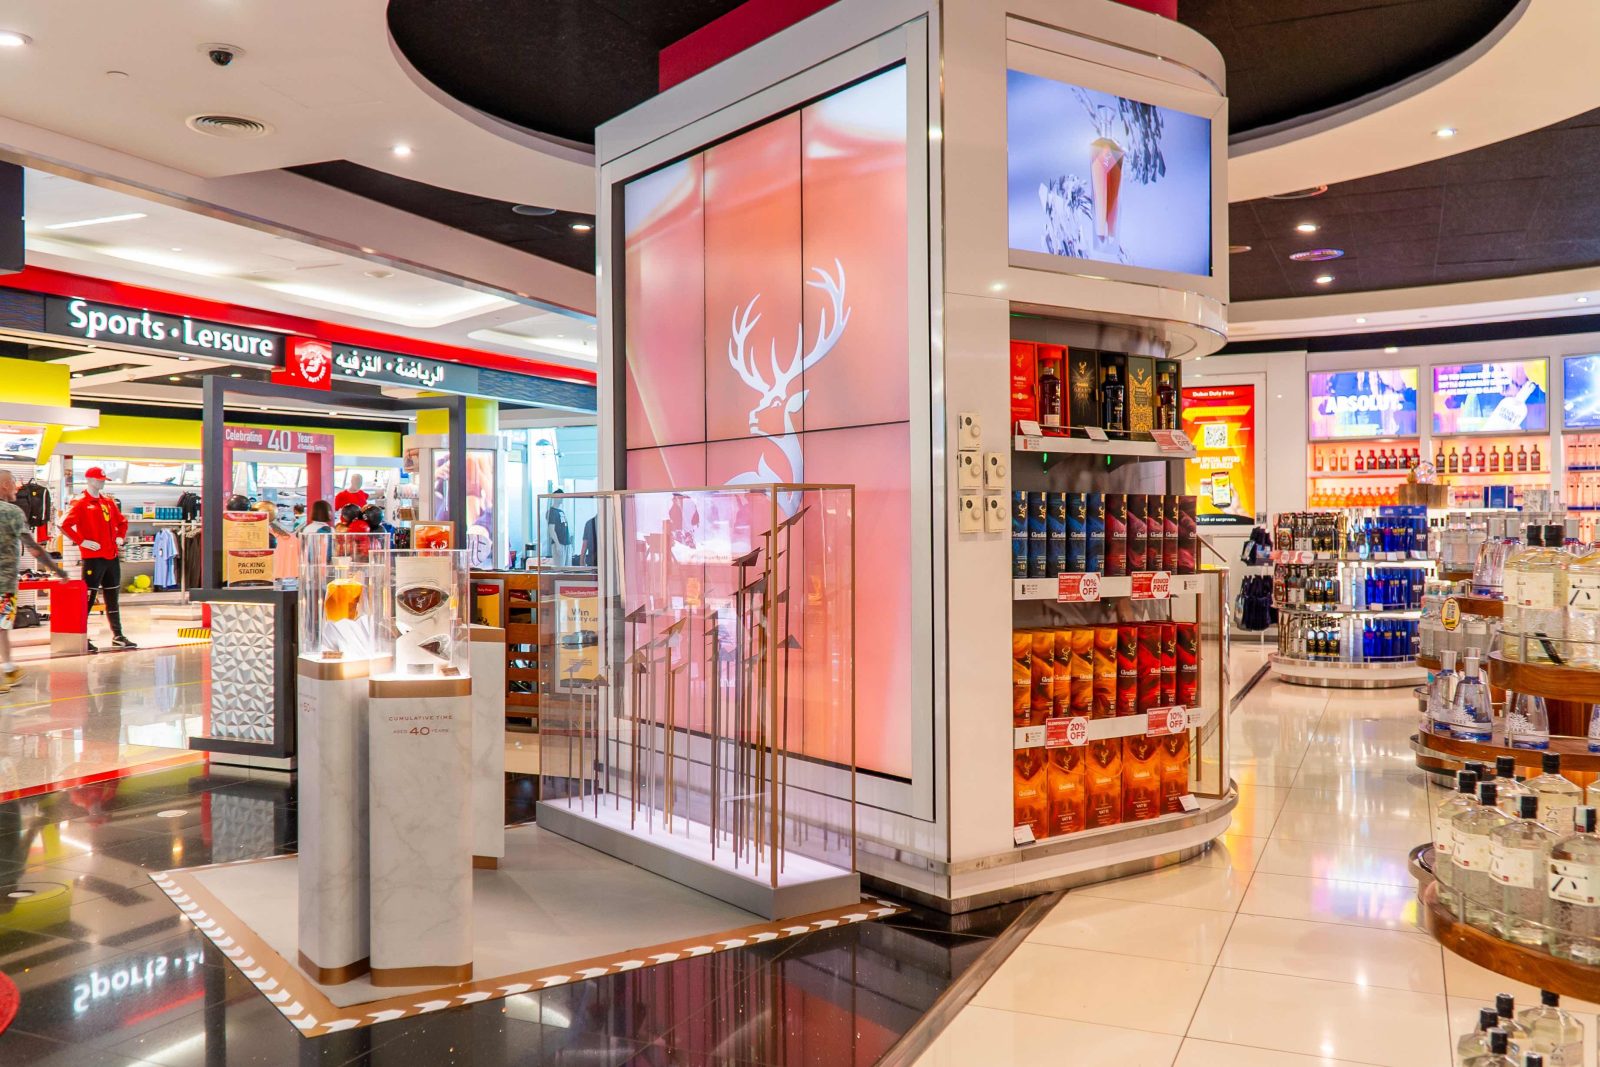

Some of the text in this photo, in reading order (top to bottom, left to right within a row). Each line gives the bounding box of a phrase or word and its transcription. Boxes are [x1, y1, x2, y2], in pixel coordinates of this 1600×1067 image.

[68, 300, 273, 356] Sports Leisure
[335, 350, 444, 387] الرياضة الترفيه
[225, 428, 314, 452] Celebrating 40 Years
[1083, 578, 1097, 587] 10%
[1082, 587, 1097, 595] OFF
[1152, 584, 1168, 592] PRICE
[1169, 711, 1183, 720] 10%
[1070, 722, 1086, 731] 20%
[1169, 719, 1183, 728] OFF
[409, 726, 430, 736] 40
[1070, 731, 1086, 740] OFF
